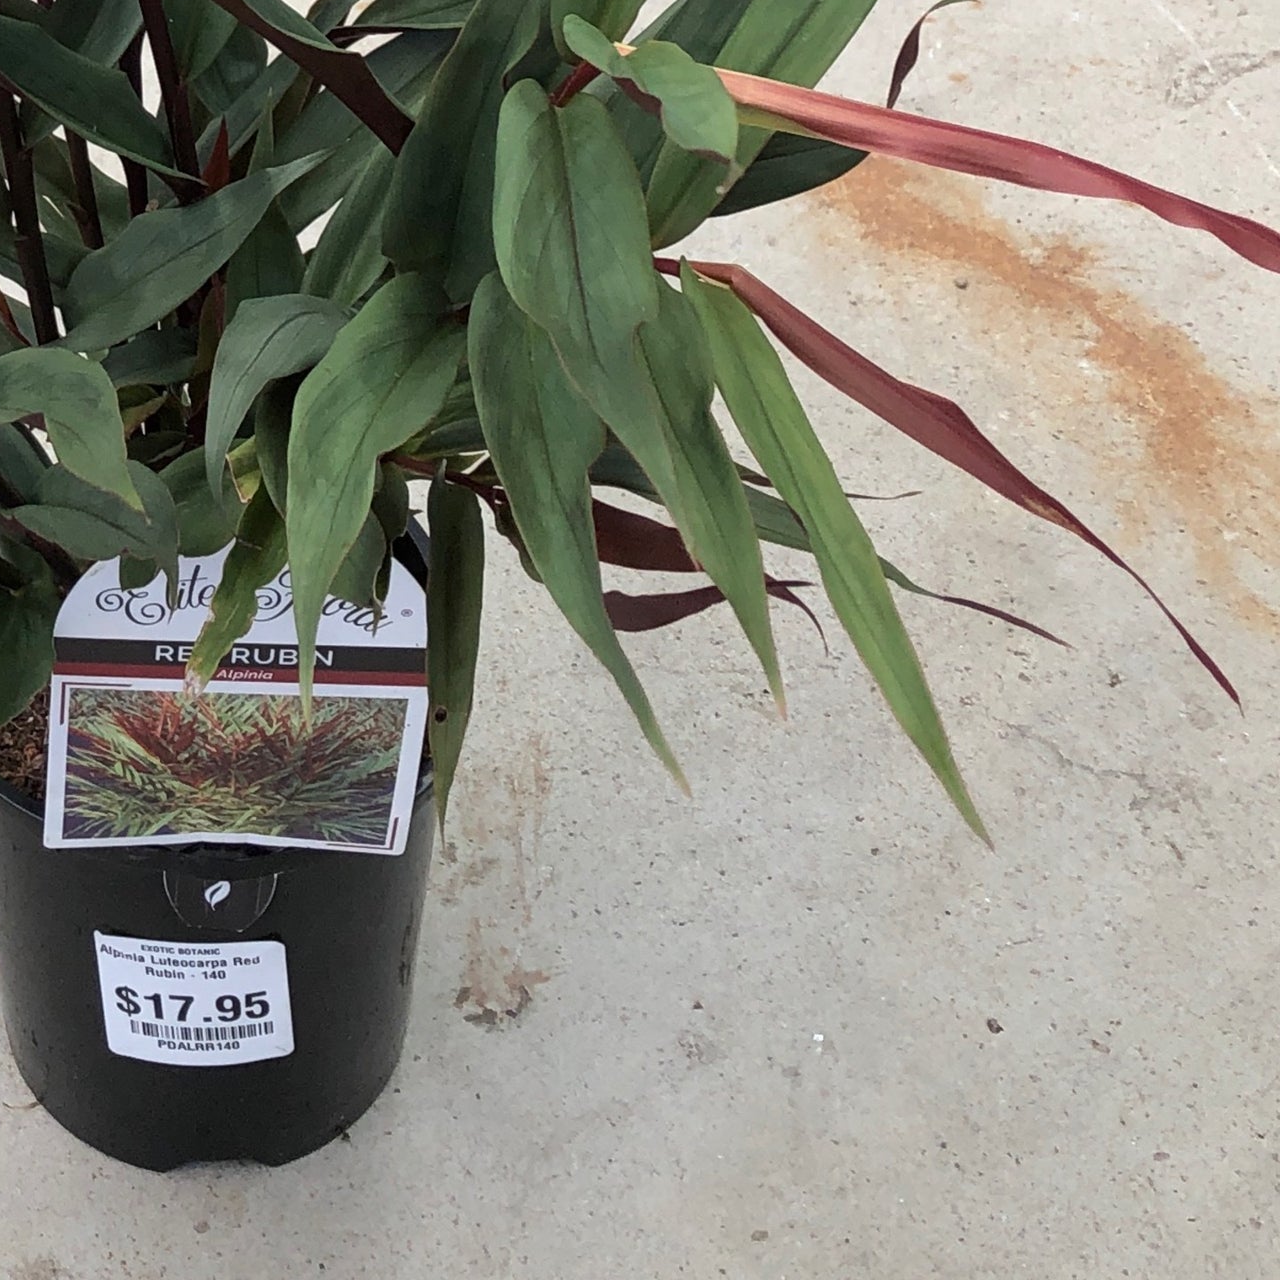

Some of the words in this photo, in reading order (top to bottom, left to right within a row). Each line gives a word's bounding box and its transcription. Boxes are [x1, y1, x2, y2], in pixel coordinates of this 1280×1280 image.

[96, 565, 216, 625] Eite
[155, 645, 196, 662] RE
[231, 647, 333, 666] RUBN
[216, 669, 273, 681] Alpinia
[140, 944, 175, 955] EXOTIC
[178, 947, 221, 956] BOTANIC
[150, 956, 228, 969] Luteocarpa
[233, 956, 261, 967] Red
[145, 966, 186, 980] Rubin
[201, 970, 227, 980] 140
[115, 985, 270, 1023] $17.95
[157, 1040, 241, 1052] PDALRR140
